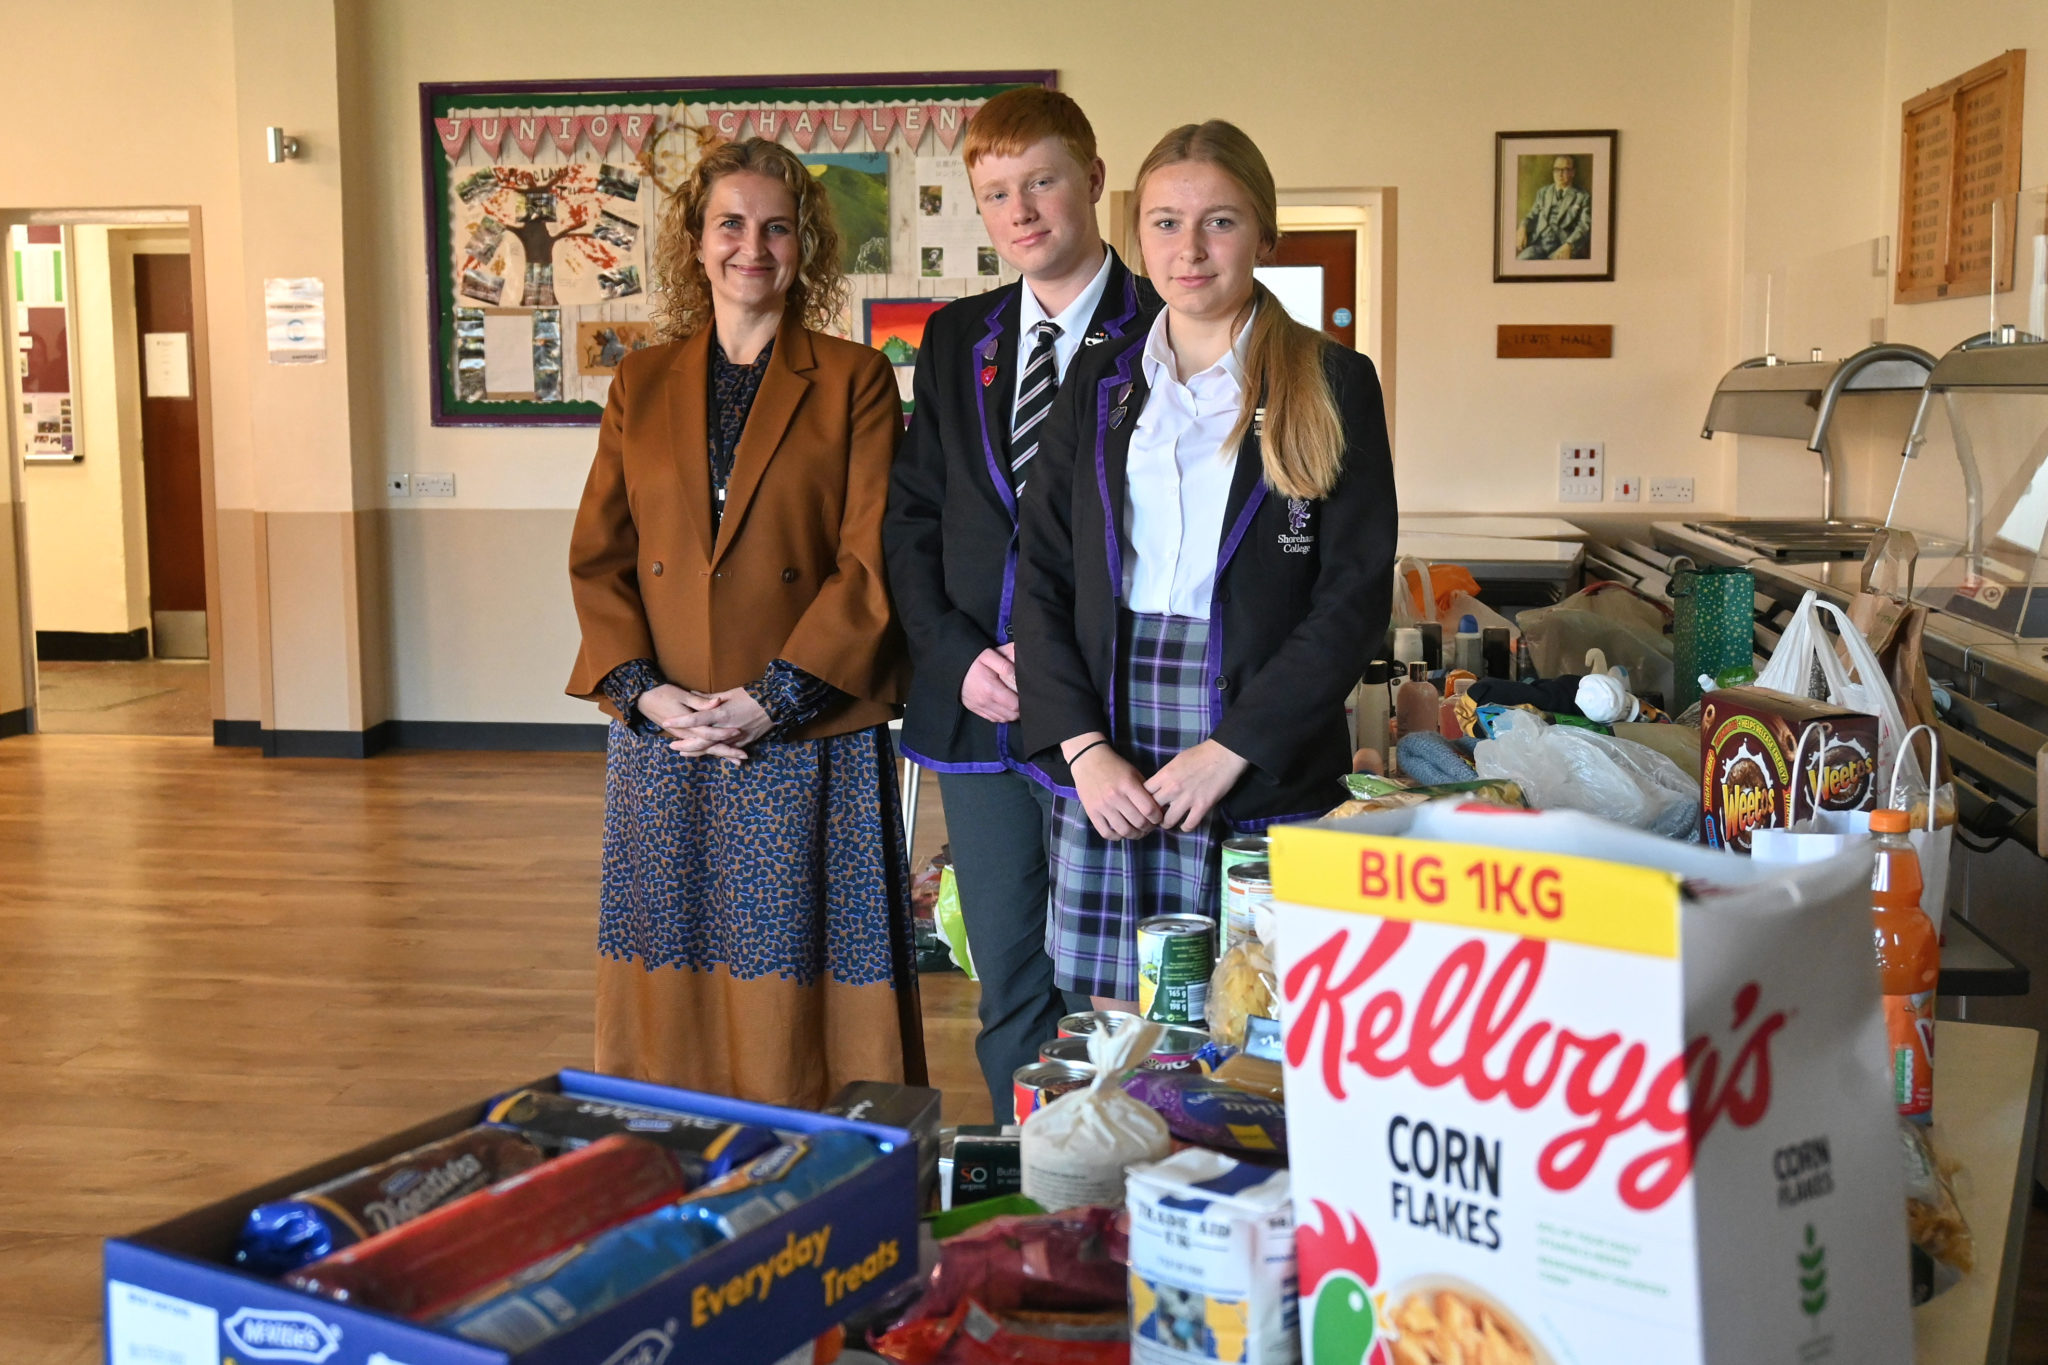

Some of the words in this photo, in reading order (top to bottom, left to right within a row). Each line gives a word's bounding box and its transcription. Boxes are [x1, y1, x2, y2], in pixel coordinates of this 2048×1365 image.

[445, 115, 642, 141] JUNIOR
[718, 107, 957, 134] CHALLEN
[1561, 333, 1593, 345] HALL
[1283, 543, 1311, 555] College
[1722, 784, 1775, 841] Weetos
[1808, 757, 1873, 801] Weetos
[1359, 849, 1447, 904] BIG
[1467, 862, 1565, 921] 1KG
[1284, 918, 1787, 1211] Kellogg's
[1388, 1115, 1500, 1199] CORN
[1393, 1182, 1501, 1253] FLAKES
[690, 1224, 832, 1327] Everyday
[822, 1239, 899, 1307] Treats
